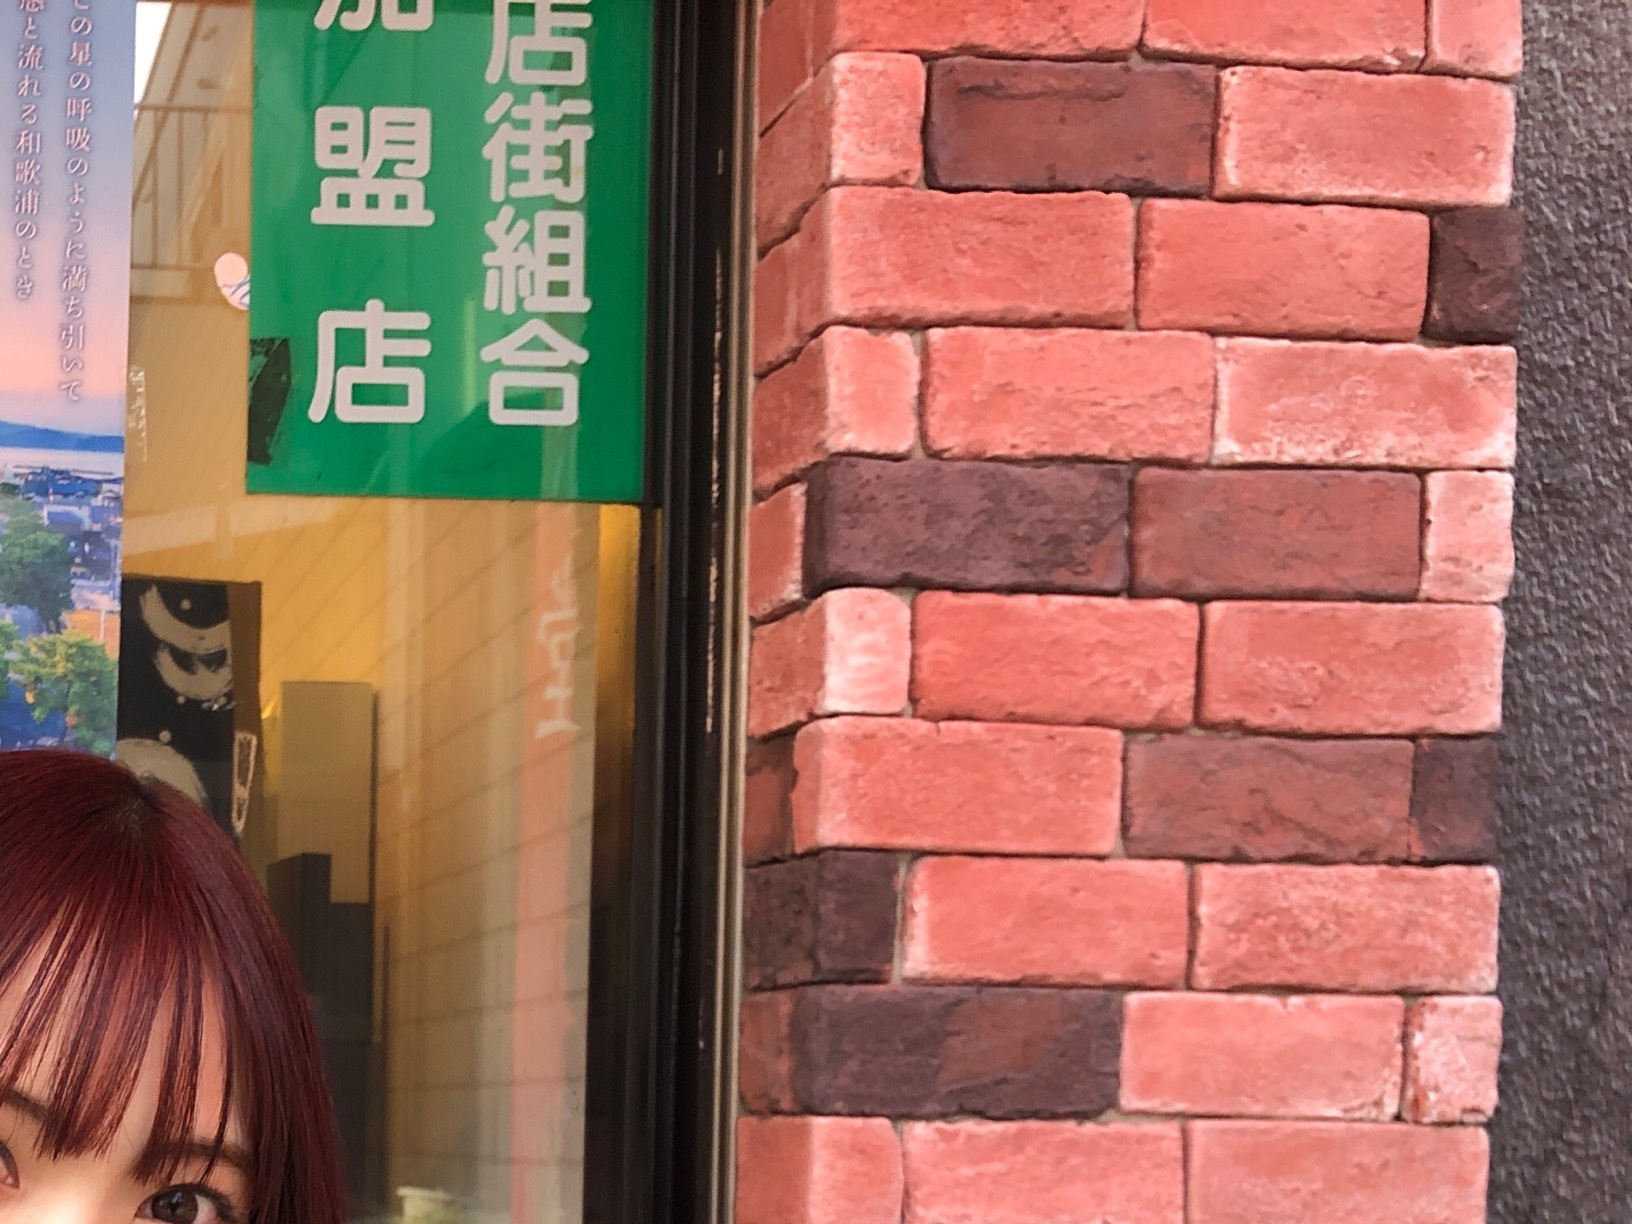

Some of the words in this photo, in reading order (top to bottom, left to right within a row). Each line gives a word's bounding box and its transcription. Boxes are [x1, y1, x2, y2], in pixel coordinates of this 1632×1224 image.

[307, 0, 436, 424] 盟店
[480, 0, 594, 428] 店街組合
